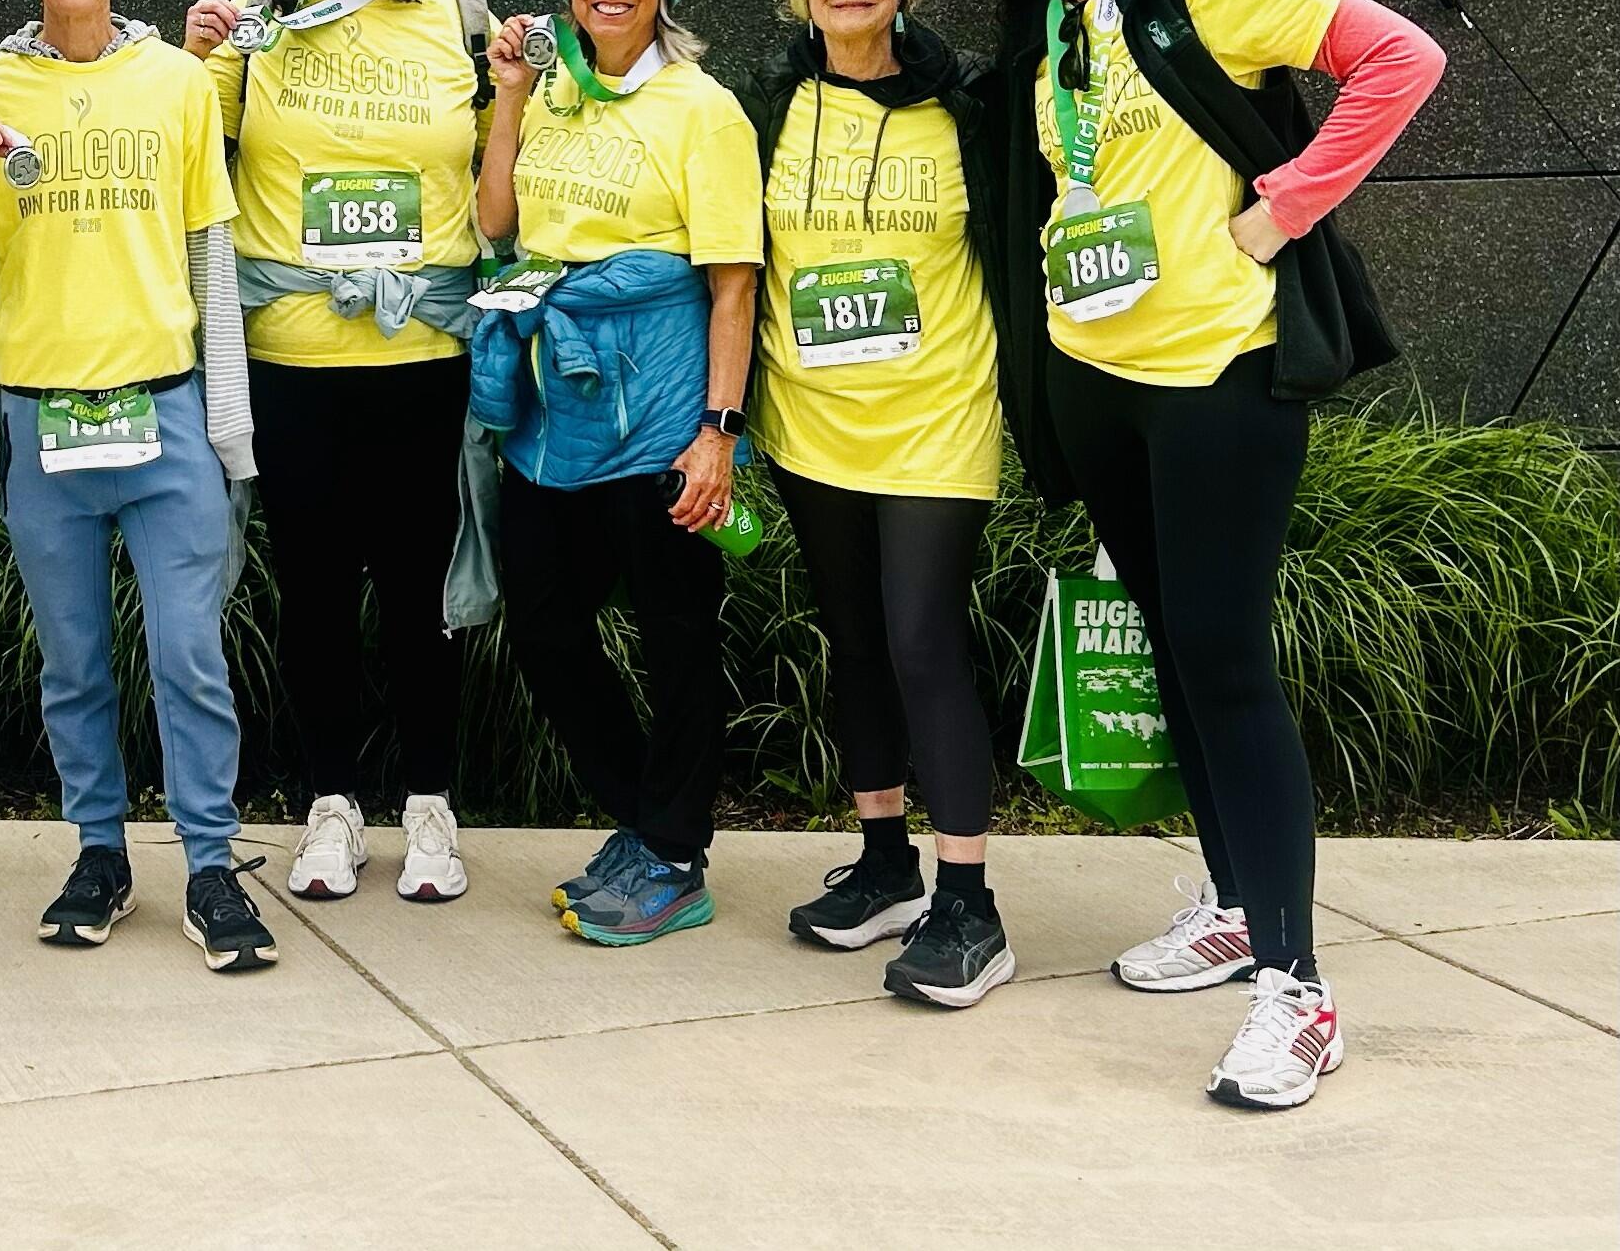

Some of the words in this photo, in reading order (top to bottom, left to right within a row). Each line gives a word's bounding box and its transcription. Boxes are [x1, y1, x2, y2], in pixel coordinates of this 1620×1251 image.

[282, 47, 430, 100] EOLCOR
[277, 88, 310, 111] RUN
[313, 95, 345, 118] FOR
[349, 100, 360, 119] A
[365, 101, 431, 126] REASON
[33, 128, 161, 184] OLCOR
[517, 126, 647, 189] EOLCOR
[532, 175, 555, 200] FOR
[556, 182, 567, 201] A
[567, 182, 631, 219] REASON
[770, 155, 937, 203] EOLCOR
[48, 189, 79, 214] FOR
[84, 189, 95, 211] A
[328, 200, 398, 234] 1858
[804, 208, 838, 232] FOR
[844, 209, 856, 232] A
[863, 208, 938, 233] REASON
[1066, 240, 1131, 288] 1816
[818, 291, 888, 332] 1817
